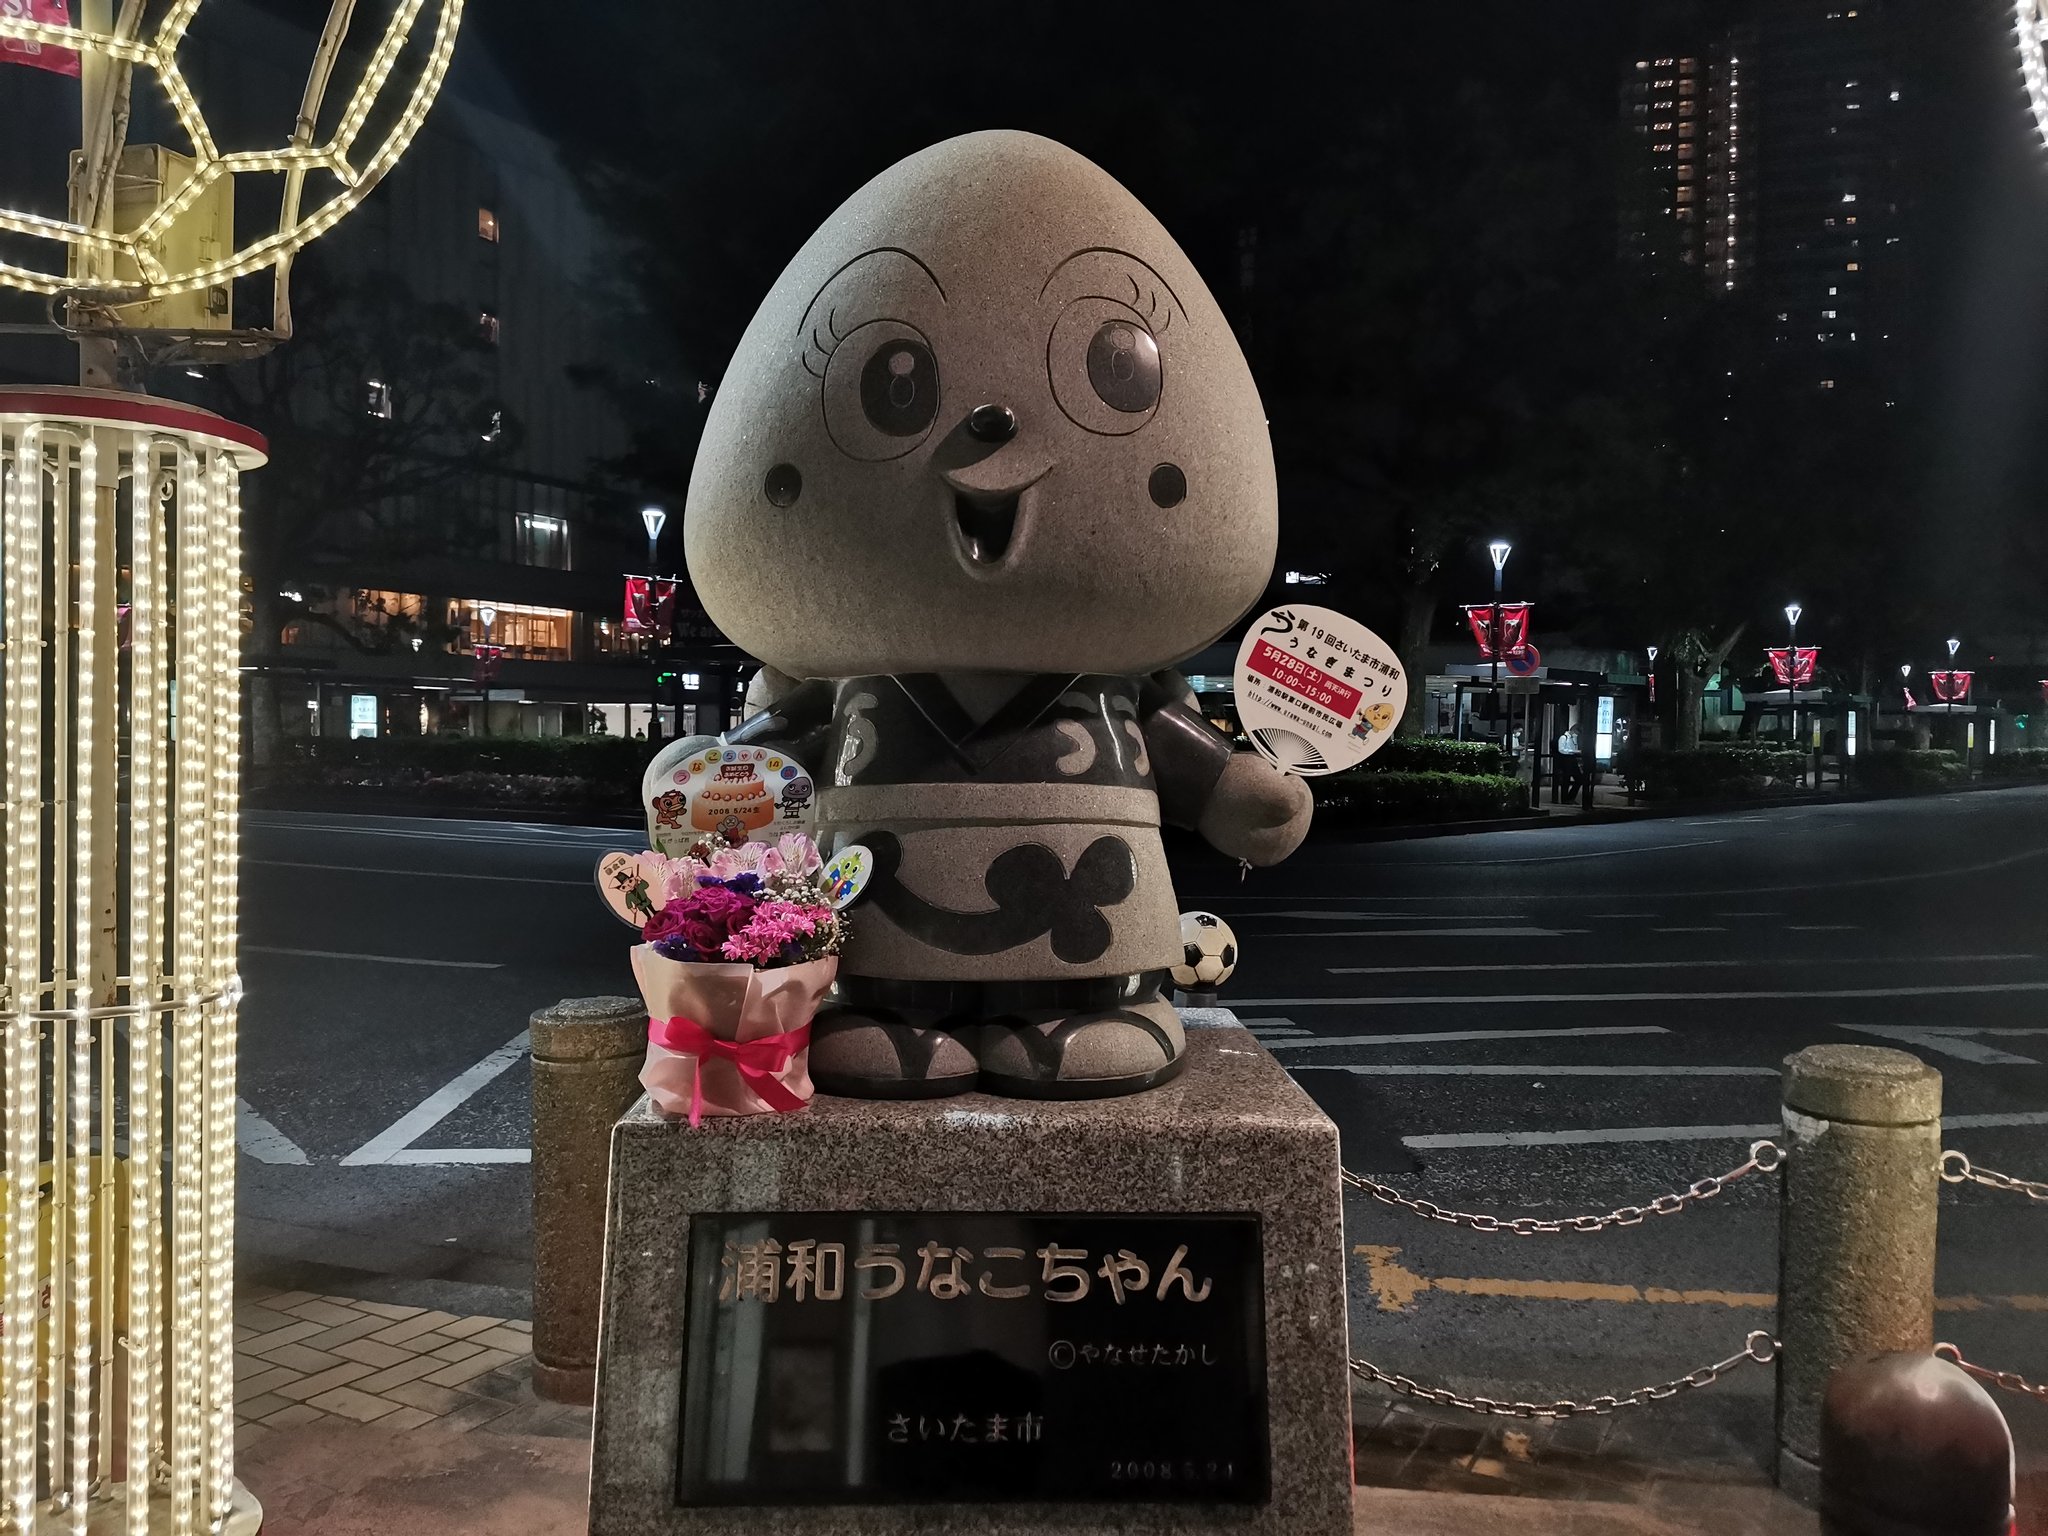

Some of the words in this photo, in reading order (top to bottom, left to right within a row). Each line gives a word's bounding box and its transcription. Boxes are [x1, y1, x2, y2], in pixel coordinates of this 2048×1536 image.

[1289, 637, 1393, 697] うなぎまつり
[718, 1237, 1214, 1304] 浦和うなこちゃん
[887, 1412, 1043, 1444] さいたま市
